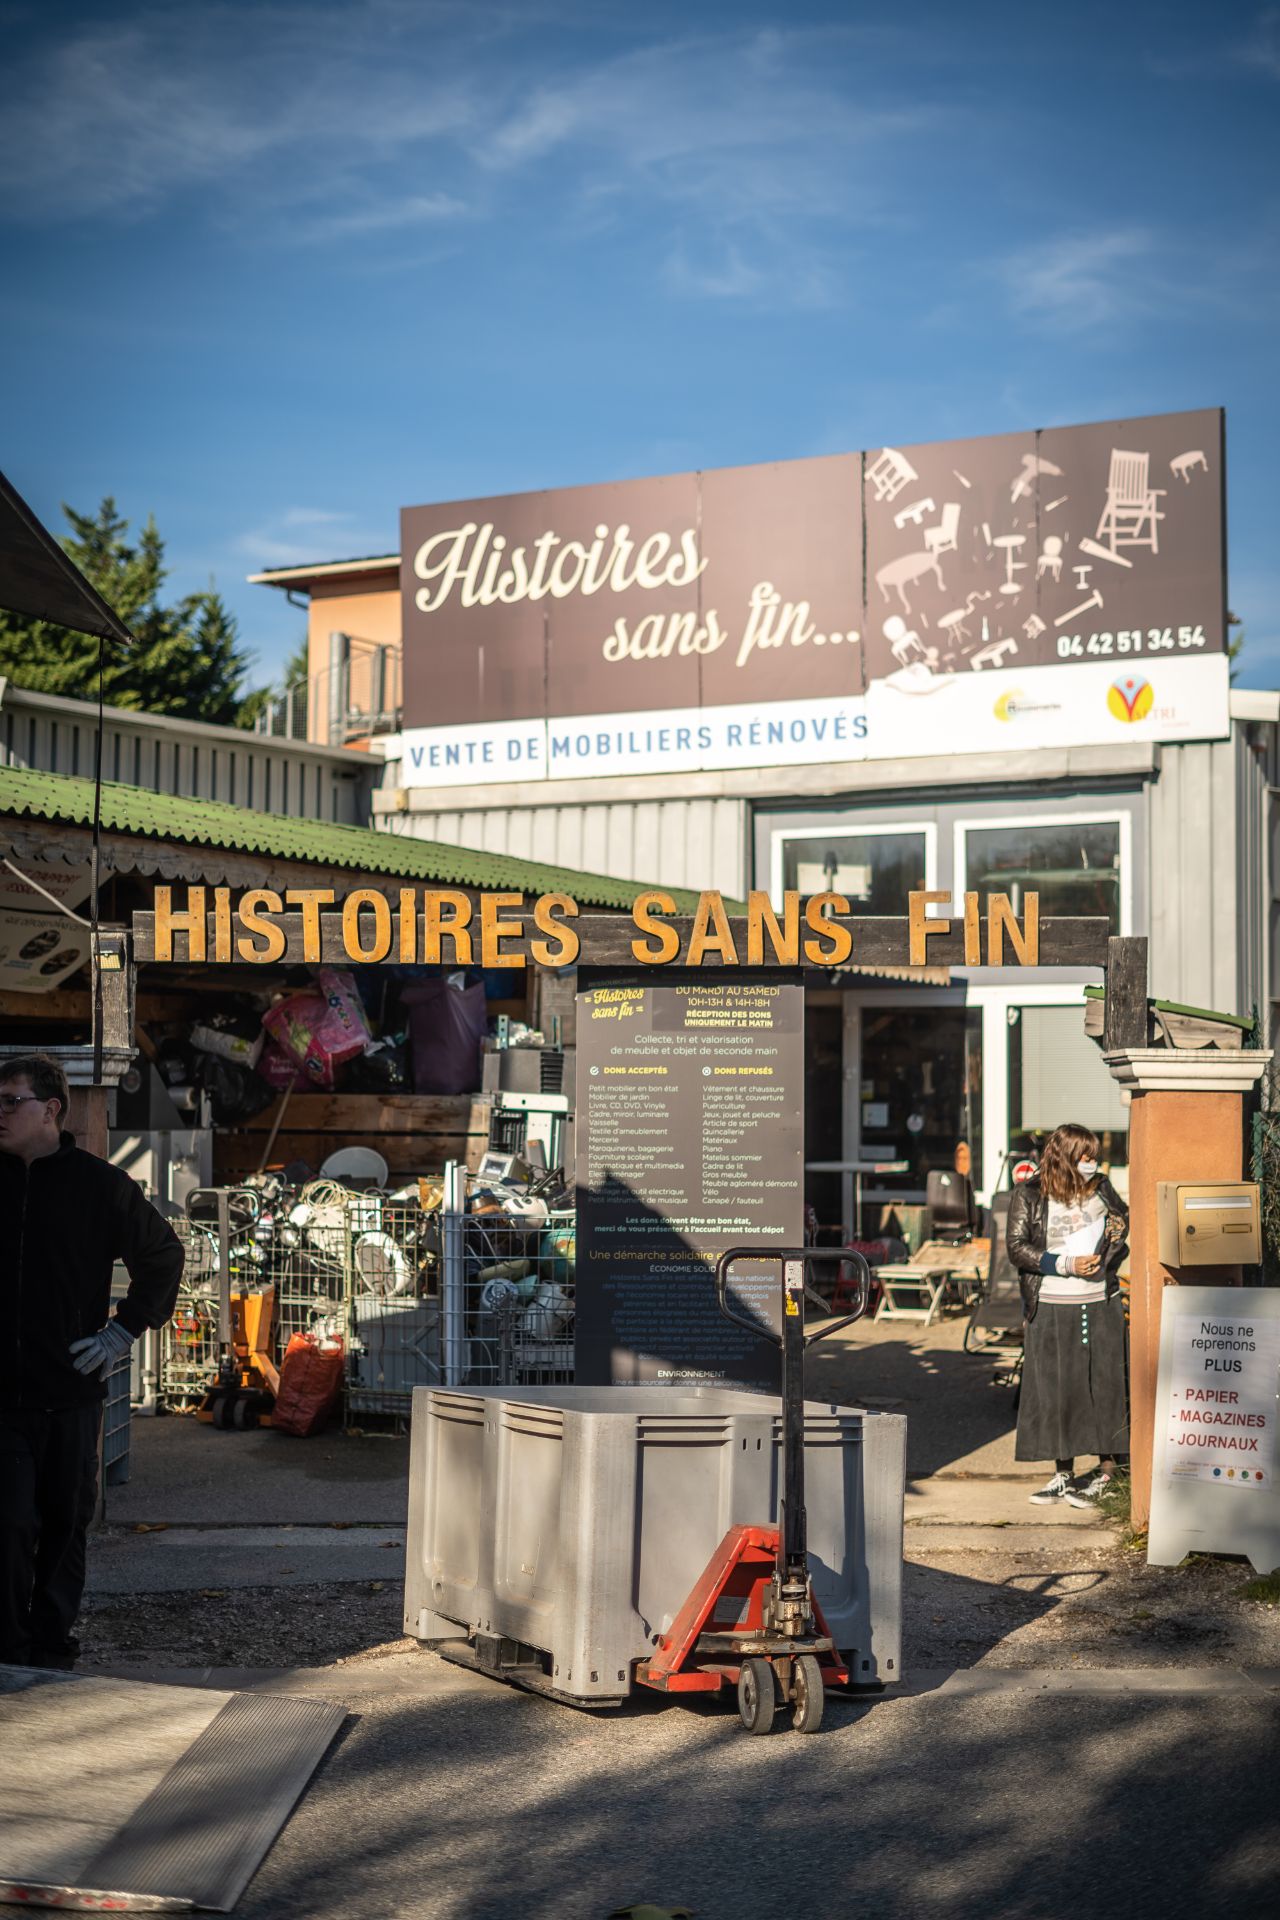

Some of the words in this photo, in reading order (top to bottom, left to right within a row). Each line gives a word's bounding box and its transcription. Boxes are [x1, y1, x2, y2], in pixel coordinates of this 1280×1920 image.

[413, 522, 709, 612] Histoires
[602, 608, 728, 662] sans
[1057, 635, 1084, 657] 04
[1086, 632, 1114, 655] 42
[1117, 630, 1142, 652] 51
[1147, 627, 1175, 650] 34
[1178, 625, 1206, 648] 54
[410, 741, 494, 768] VENTE
[507, 737, 539, 761] DE
[552, 726, 712, 758] MOBILIERS
[727, 710, 869, 747] RÉNOVÉS
[153, 885, 580, 968] HISTOIRES
[632, 890, 853, 967] SANS
[908, 890, 1040, 967] FIN
[676, 986, 689, 995] DU
[692, 986, 724, 995] MARDI
[726, 986, 740, 995] AU
[743, 986, 780, 996] SAMEDI
[593, 989, 645, 1004] Histoires
[688, 998, 724, 1006] 10H-13H
[726, 998, 733, 1006] &
[735, 998, 771, 1007] 14H-18H
[592, 1006, 618, 1019] sans
[618, 1001, 634, 1021] fin
[686, 1009, 730, 1018] RÉCEPTION
[684, 1019, 736, 1027] UNIQUEMENT
[748, 1020, 773, 1028] MATIN
[634, 1034, 674, 1044] Collecte,
[676, 1035, 686, 1044] tri
[688, 1036, 698, 1044] et
[701, 1035, 754, 1044] valorisation
[610, 1046, 623, 1055] de
[624, 1046, 659, 1055] meuble
[661, 1047, 671, 1055] et
[673, 1046, 697, 1057] objet
[699, 1046, 712, 1055] de
[713, 1046, 752, 1055] seconde
[754, 1046, 778, 1055] main
[603, 1067, 626, 1075] DONS
[627, 1065, 668, 1075] ACCEPTÉS
[713, 1067, 737, 1075] DONS
[738, 1066, 774, 1075] REFUSÉS
[748, 1085, 785, 1093] chaussure
[629, 1094, 650, 1102] jardin
[702, 1094, 723, 1102] Linge
[643, 1102, 666, 1110] Vinyle
[722, 1111, 740, 1119] jouet
[751, 1111, 781, 1119] peluche
[738, 1120, 758, 1128] sport
[702, 1136, 738, 1144] Matériaux
[637, 1145, 674, 1153] bagagerie
[588, 1162, 634, 1170] Informatique
[729, 1180, 764, 1188] agloméré
[702, 1197, 729, 1205] Canapé
[733, 1217, 751, 1225] état,
[647, 1225, 683, 1233] présenter
[691, 1225, 721, 1233] l'accueil
[589, 1251, 611, 1260] Une
[613, 1250, 668, 1260] démarche
[669, 1250, 714, 1260] solidaire
[650, 1264, 691, 1273] ÉCONOMIE
[1201, 1322, 1233, 1337] Nous
[1238, 1326, 1254, 1337] ne
[1191, 1337, 1256, 1353] reprenons
[1204, 1358, 1242, 1374] PLUS
[657, 1369, 727, 1377] ENVIRONNEMENT
[1186, 1388, 1239, 1404] PAPIER
[1180, 1410, 1266, 1428] MAGAZINES
[1178, 1434, 1258, 1452] JOURNAUX
